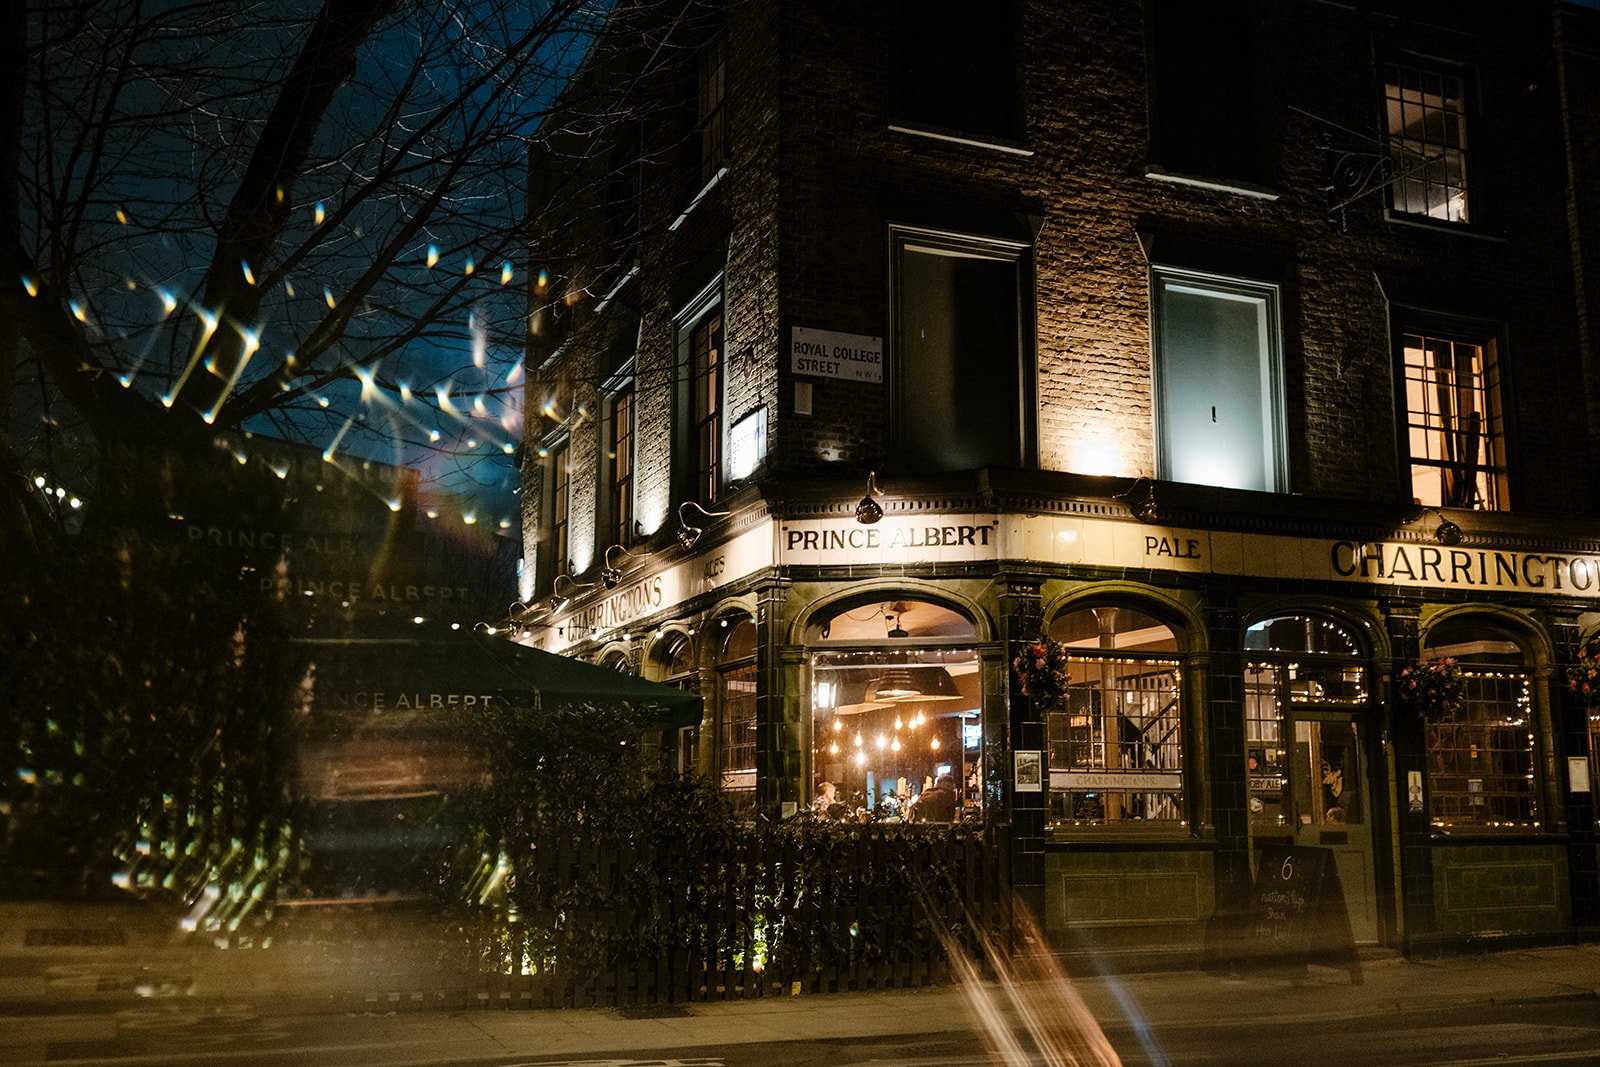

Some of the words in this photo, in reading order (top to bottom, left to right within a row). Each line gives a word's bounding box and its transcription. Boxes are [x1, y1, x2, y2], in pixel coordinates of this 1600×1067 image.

[794, 341, 828, 358] ROYAL
[833, 347, 881, 364] COLLEGE
[797, 358, 840, 374] STREET
[1144, 535, 1200, 559] PALE
[1331, 540, 1600, 592] CHARRINGTO
[567, 576, 663, 643] CHARRINGTONS
[703, 555, 726, 578] ALES
[394, 693, 493, 709] ALBERT
[1281, 855, 1293, 880] 6
